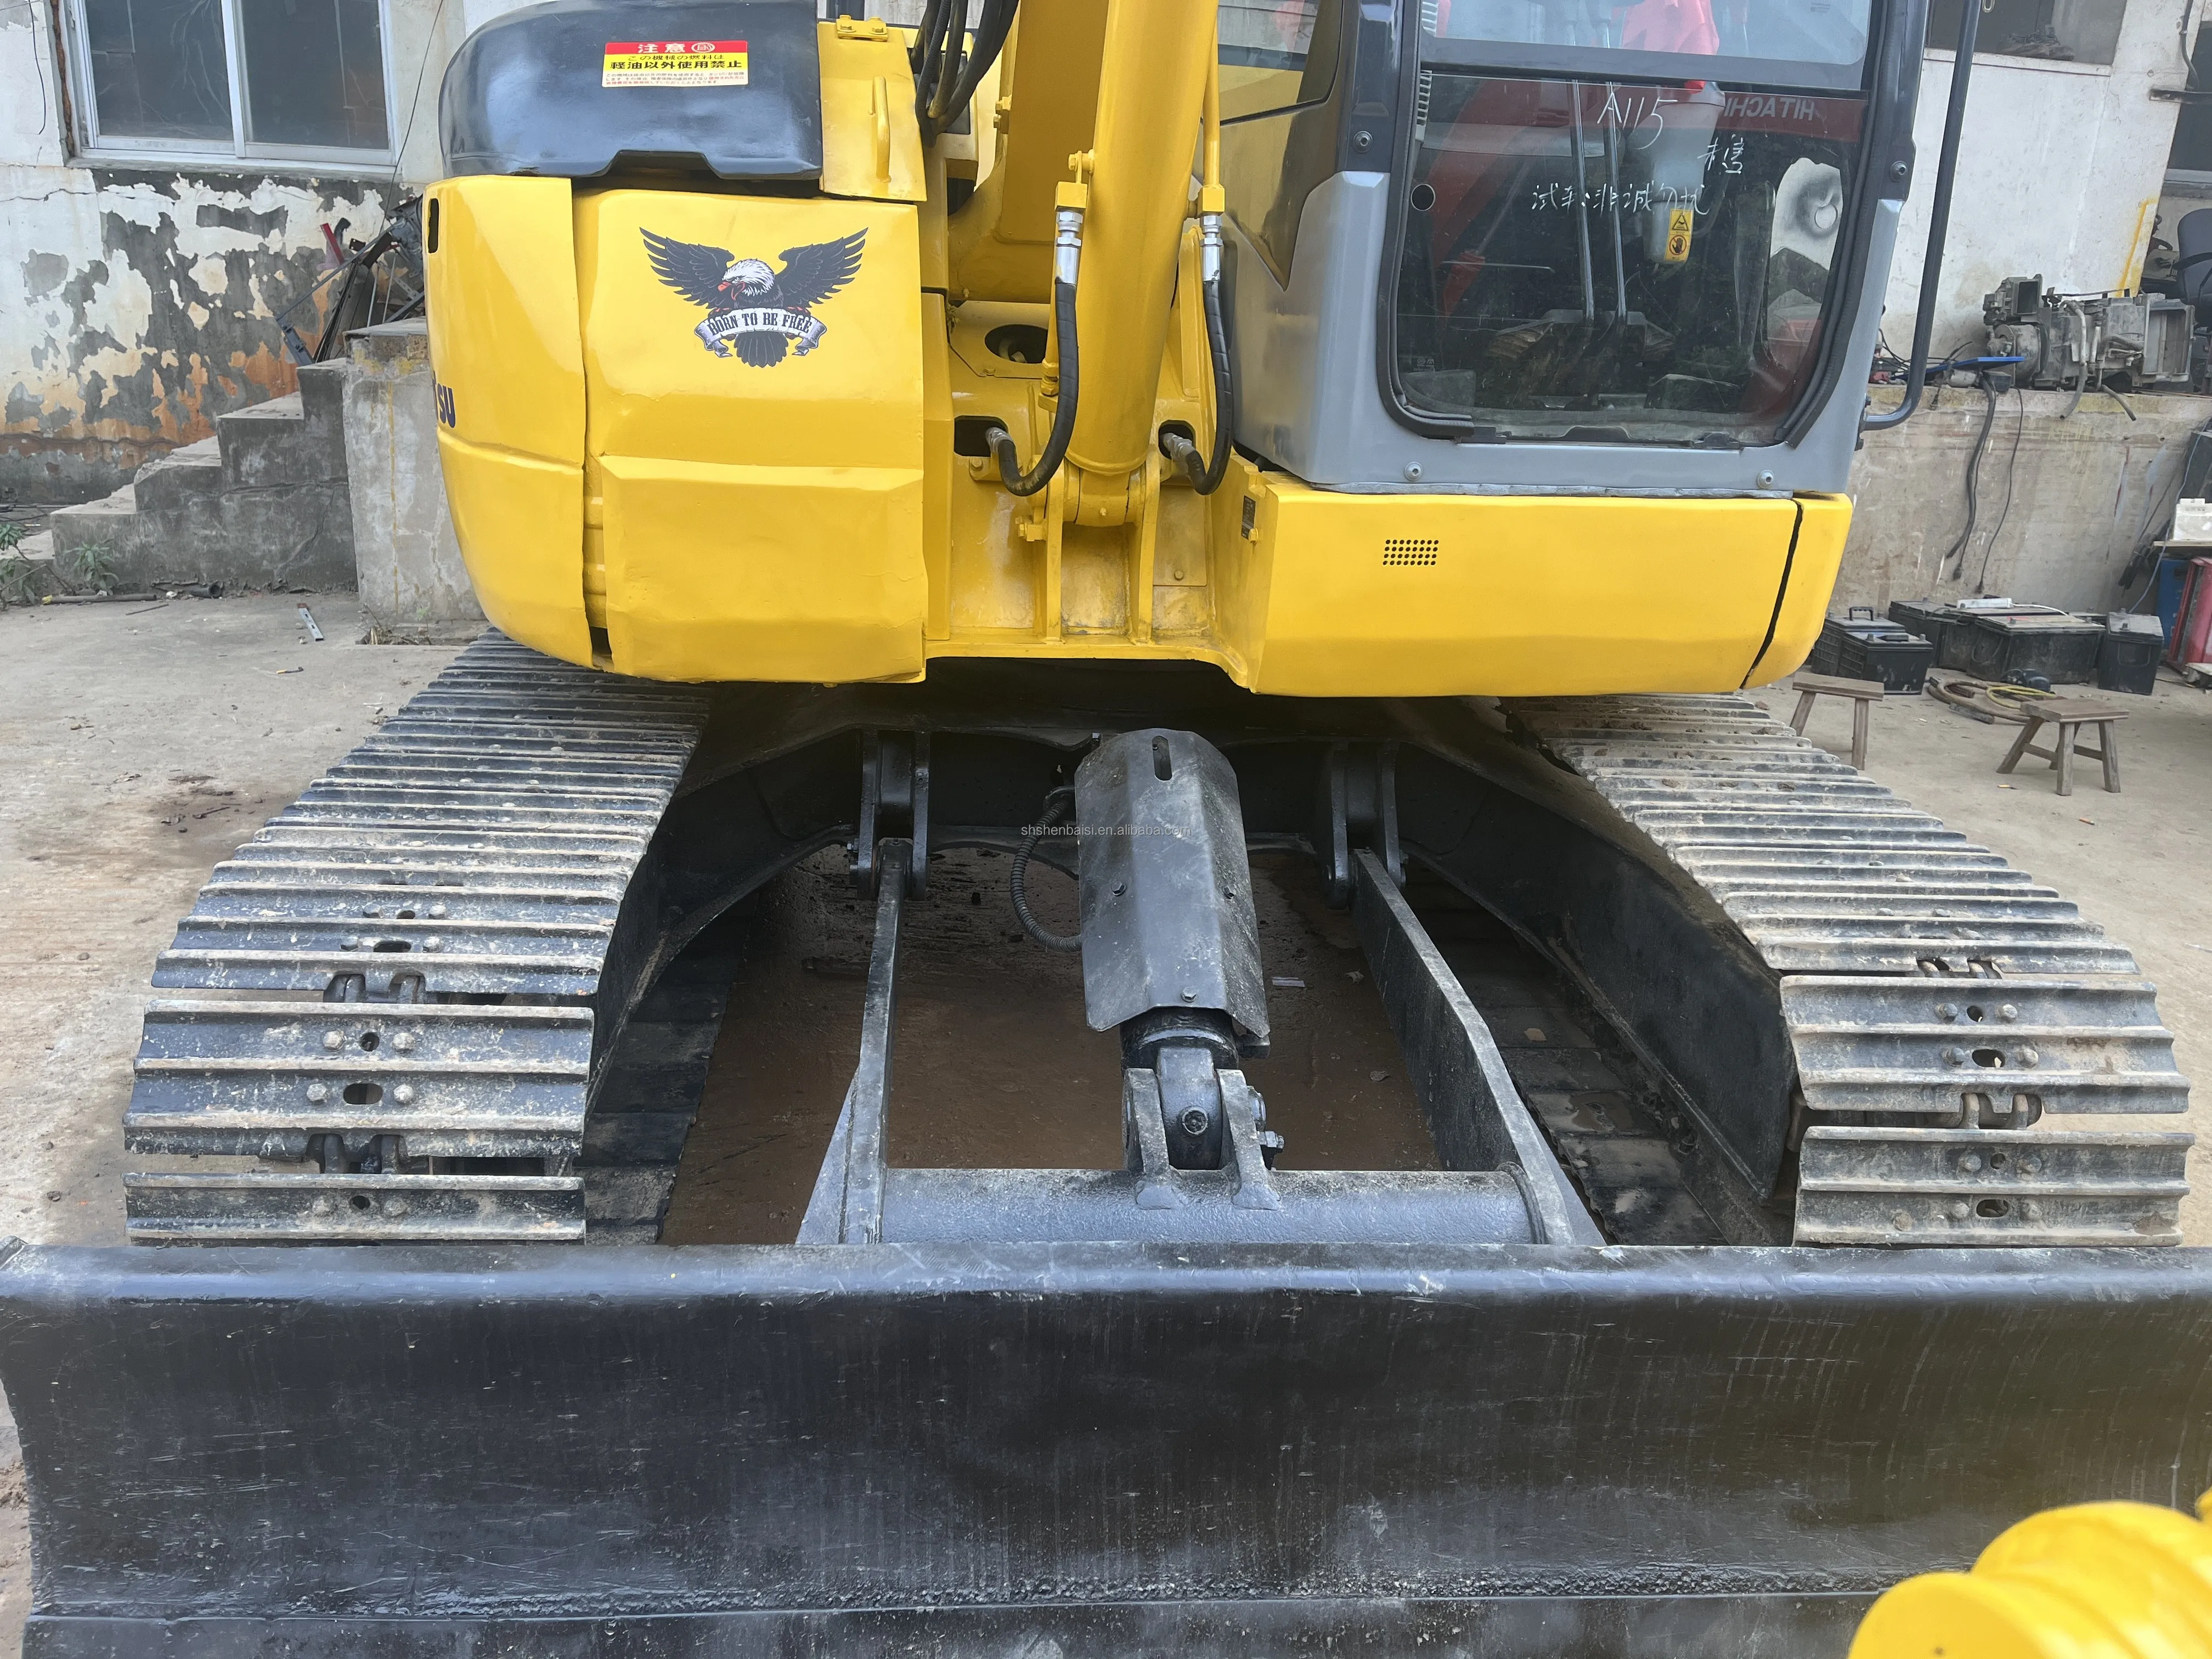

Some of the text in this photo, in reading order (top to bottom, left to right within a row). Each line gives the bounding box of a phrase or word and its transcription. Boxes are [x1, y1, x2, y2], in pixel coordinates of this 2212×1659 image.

[611, 60, 742, 69] 軽油以外使用禁止
[707, 312, 812, 336] BORN TO BE FREE
[433, 374, 456, 428] SU
